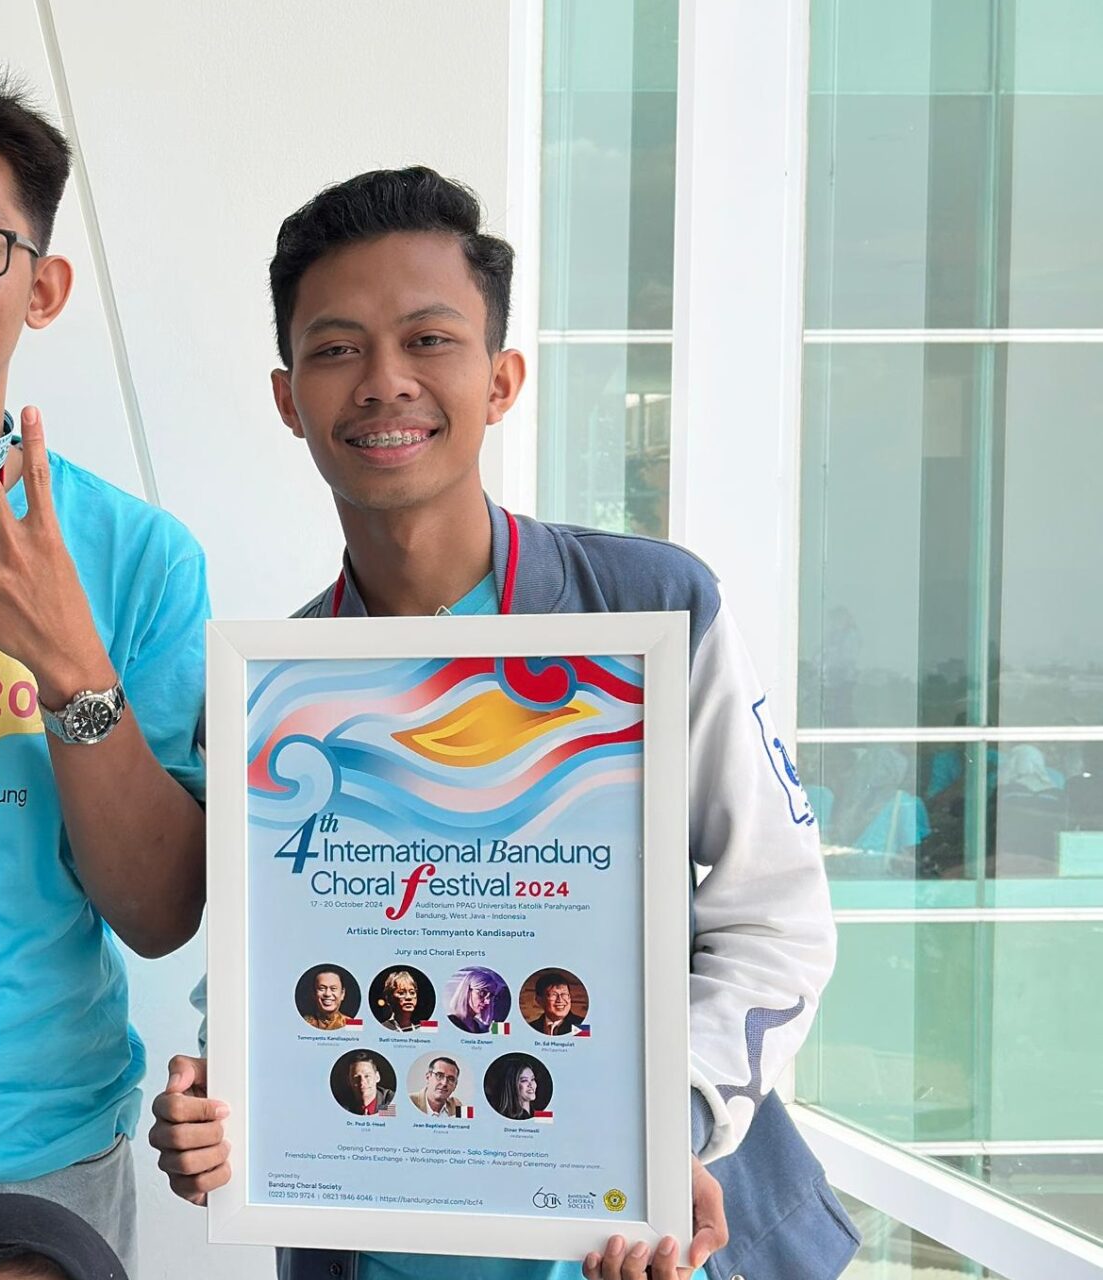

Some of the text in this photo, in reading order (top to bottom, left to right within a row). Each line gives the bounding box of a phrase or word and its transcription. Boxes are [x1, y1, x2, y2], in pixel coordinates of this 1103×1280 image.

[274, 812, 611, 875] 4th International Bandung
[311, 863, 570, 921] Choral festival 2024
[478, 902, 517, 910] Universitas
[544, 903, 590, 912] Parahyangan
[415, 912, 448, 920] Bandung,
[346, 926, 535, 939] Artistic Director: Tommyanto Kandisaputra
[394, 948, 486, 958] Jury and Choral Experts
[337, 1144, 363, 1152] Opening
[364, 1145, 397, 1154] Ceremony
[421, 1147, 460, 1156] Competition
[483, 1149, 507, 1158] Singing
[508, 1150, 549, 1159] Competition
[285, 1152, 316, 1160] Friendship
[373, 1155, 403, 1163] Exchange
[449, 1157, 466, 1165] Choir
[491, 1159, 522, 1168] Awarding
[523, 1160, 556, 1169] Ceremony
[268, 1181, 295, 1189] Bandung
[318, 1182, 342, 1190] Society
